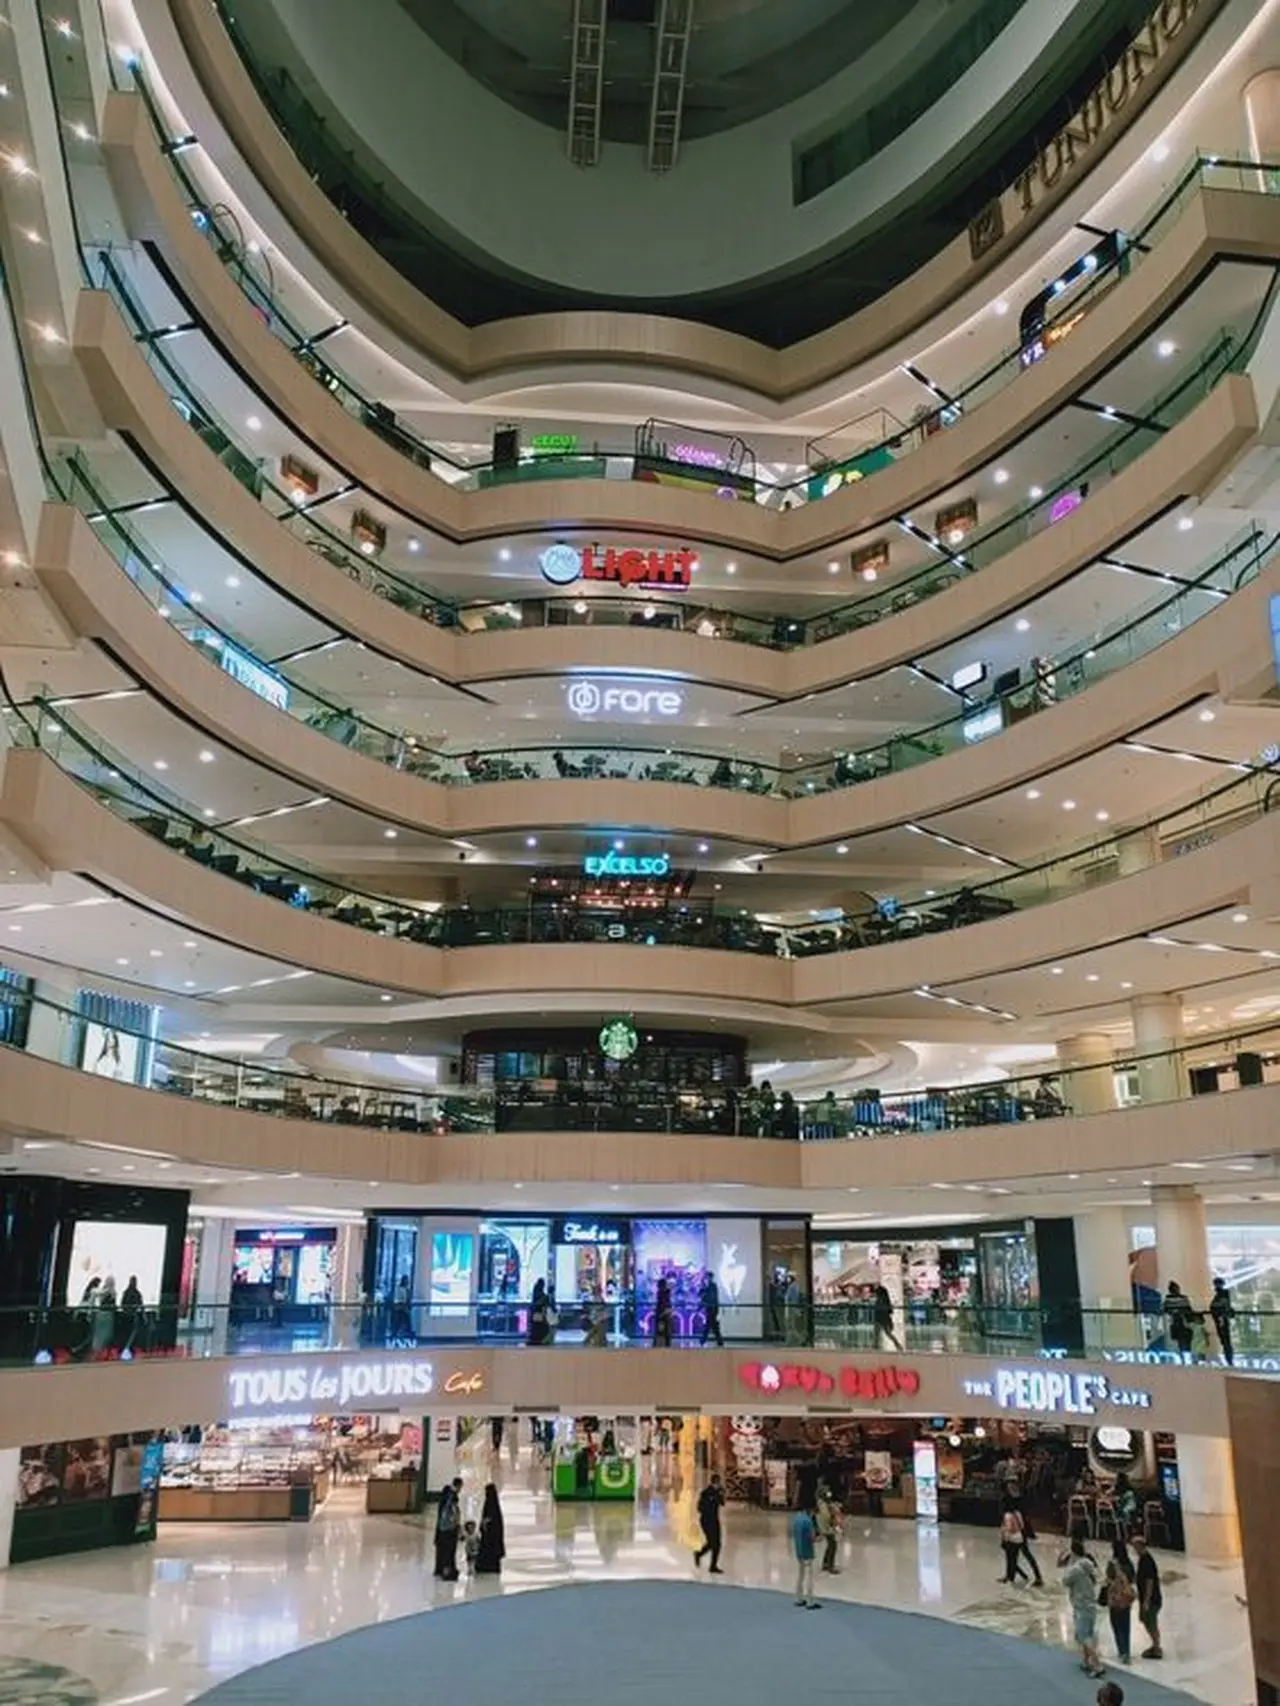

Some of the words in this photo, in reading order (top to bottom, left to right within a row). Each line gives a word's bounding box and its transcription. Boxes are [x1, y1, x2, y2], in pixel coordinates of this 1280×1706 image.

[229, 1368, 307, 1407] TOUS
[339, 1363, 433, 1404] JOURS
[997, 1370, 1108, 1414] PEOPLE'S
